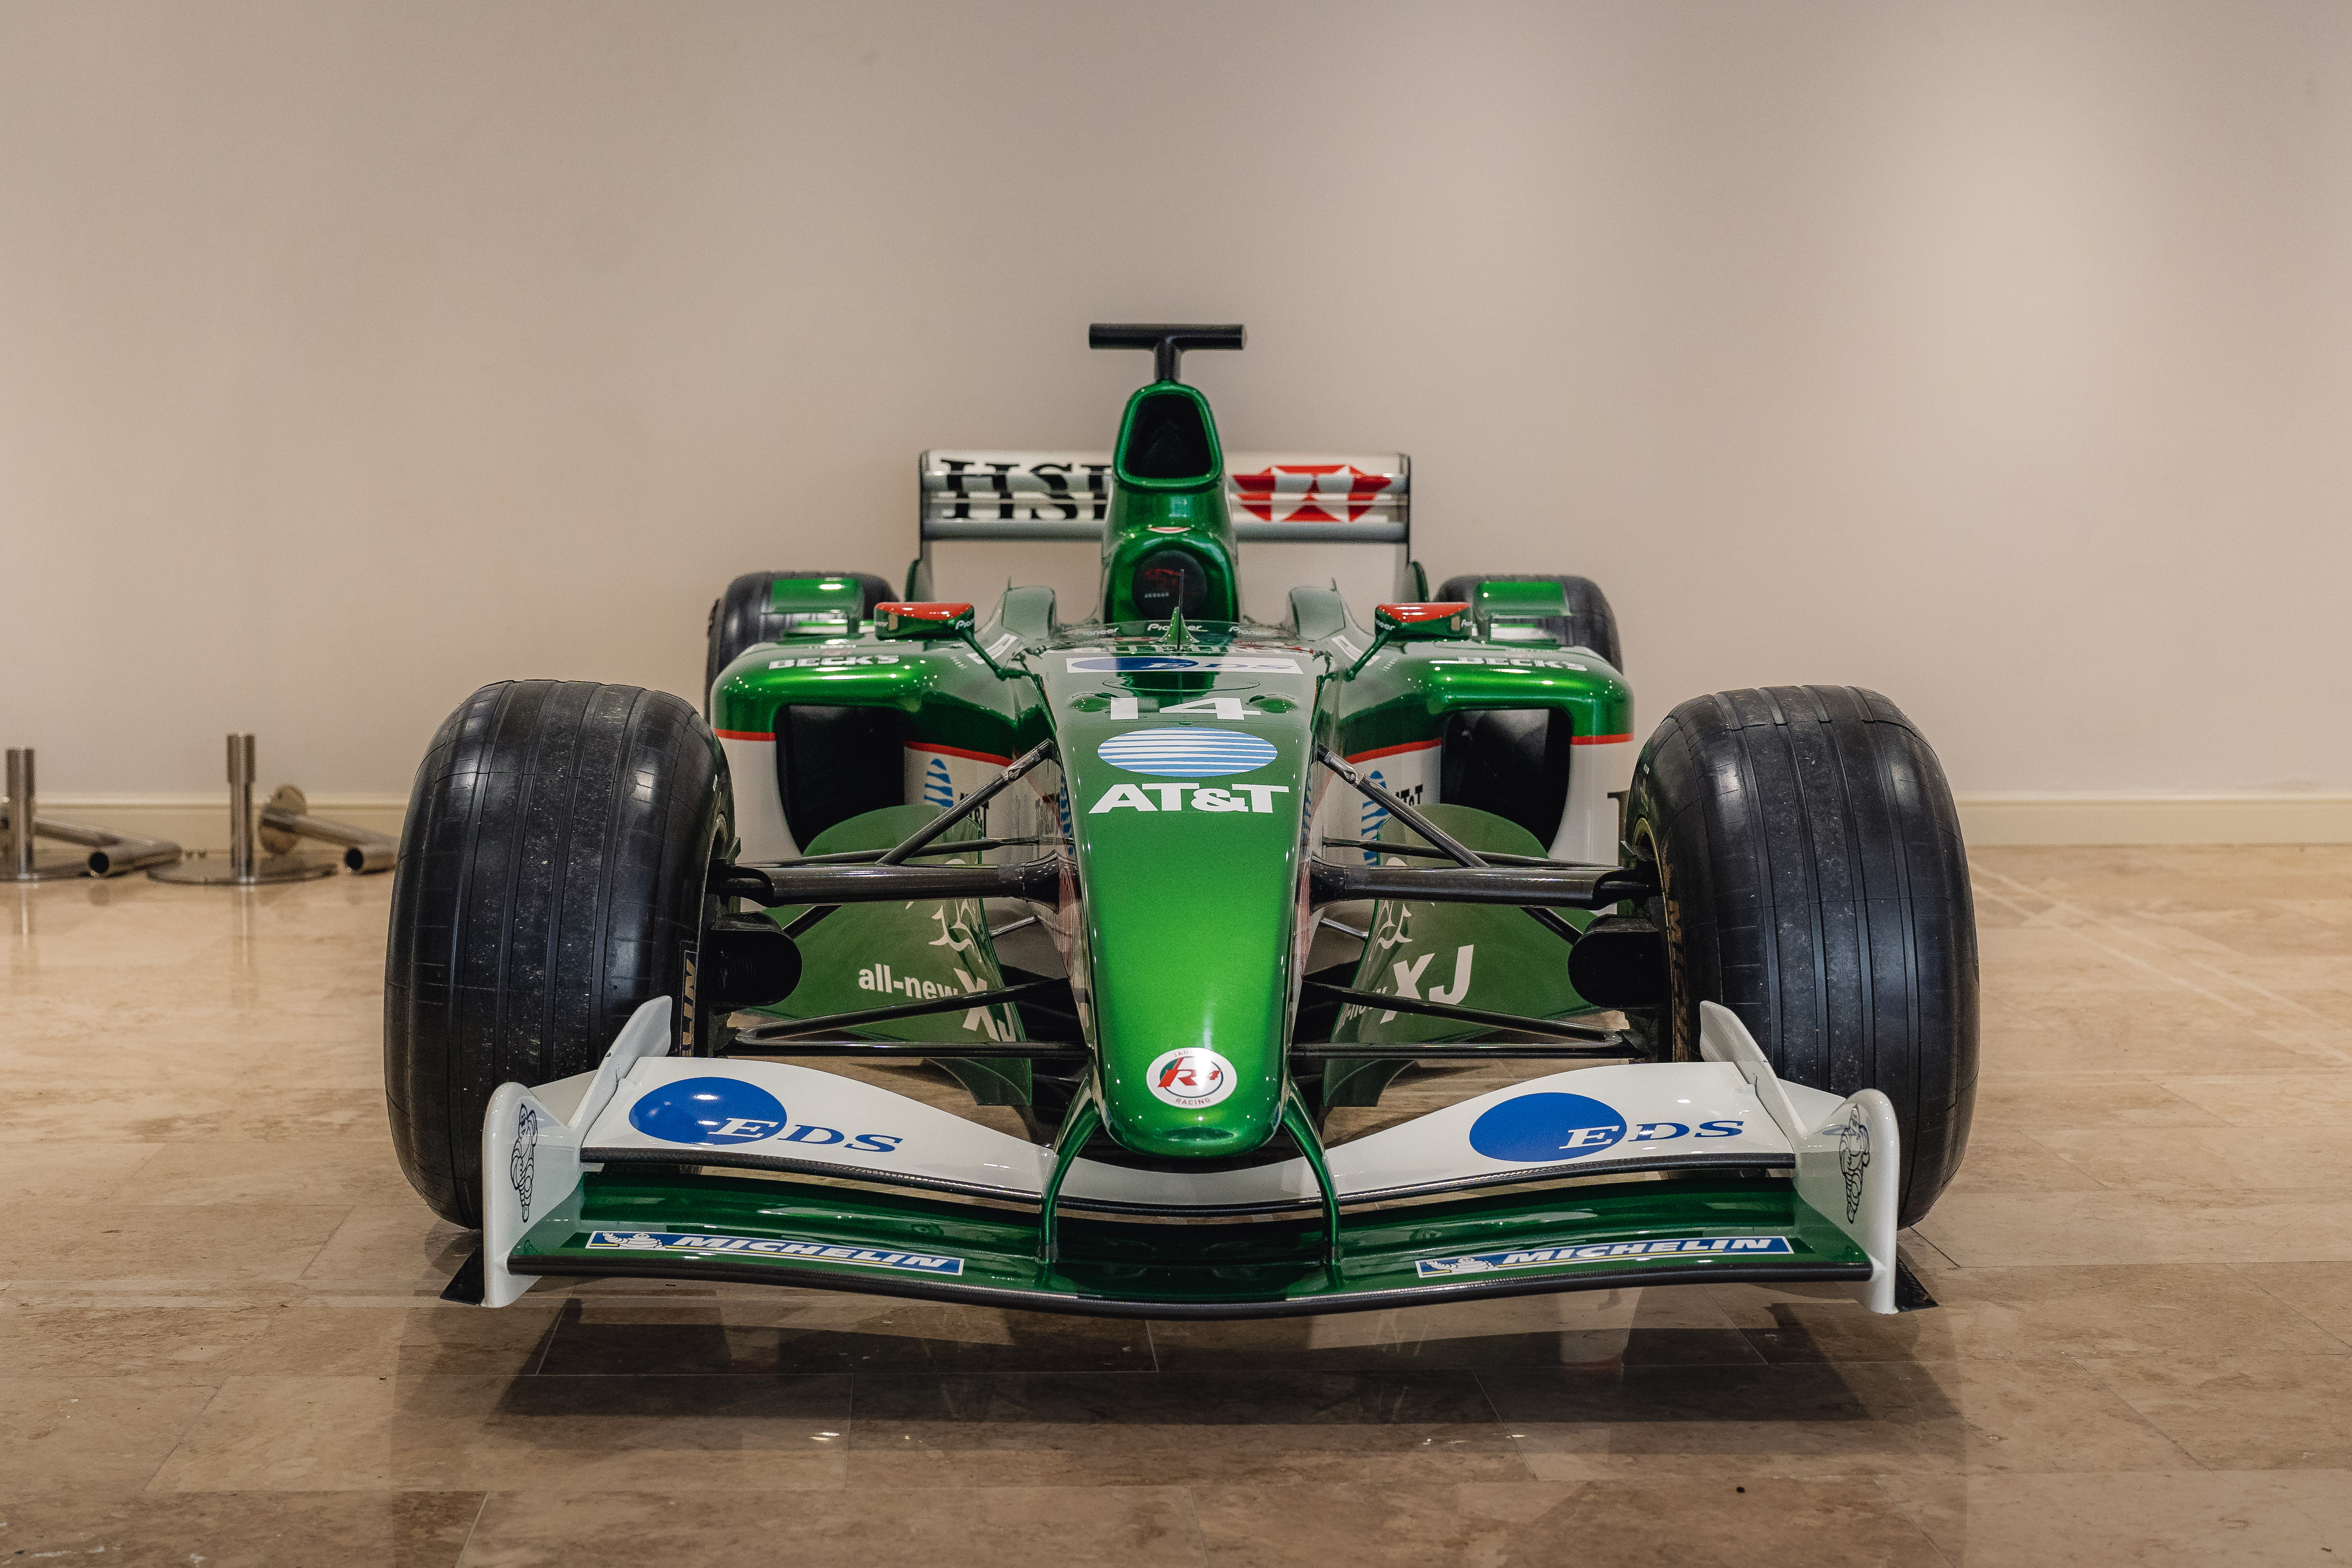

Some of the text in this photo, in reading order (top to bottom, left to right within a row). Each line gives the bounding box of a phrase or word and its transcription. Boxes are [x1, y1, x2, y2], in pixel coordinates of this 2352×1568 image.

[1110, 697, 1261, 721] 14
[1088, 782, 1290, 814] AT&T
[858, 963, 958, 999] all-new
[1379, 944, 1475, 1024] XJ
[707, 1117, 904, 1153] EDS
[1558, 1120, 1744, 1150] EDS
[673, 1236, 948, 1268] MICHELIN
[1502, 1238, 1775, 1264] MICHELIN
